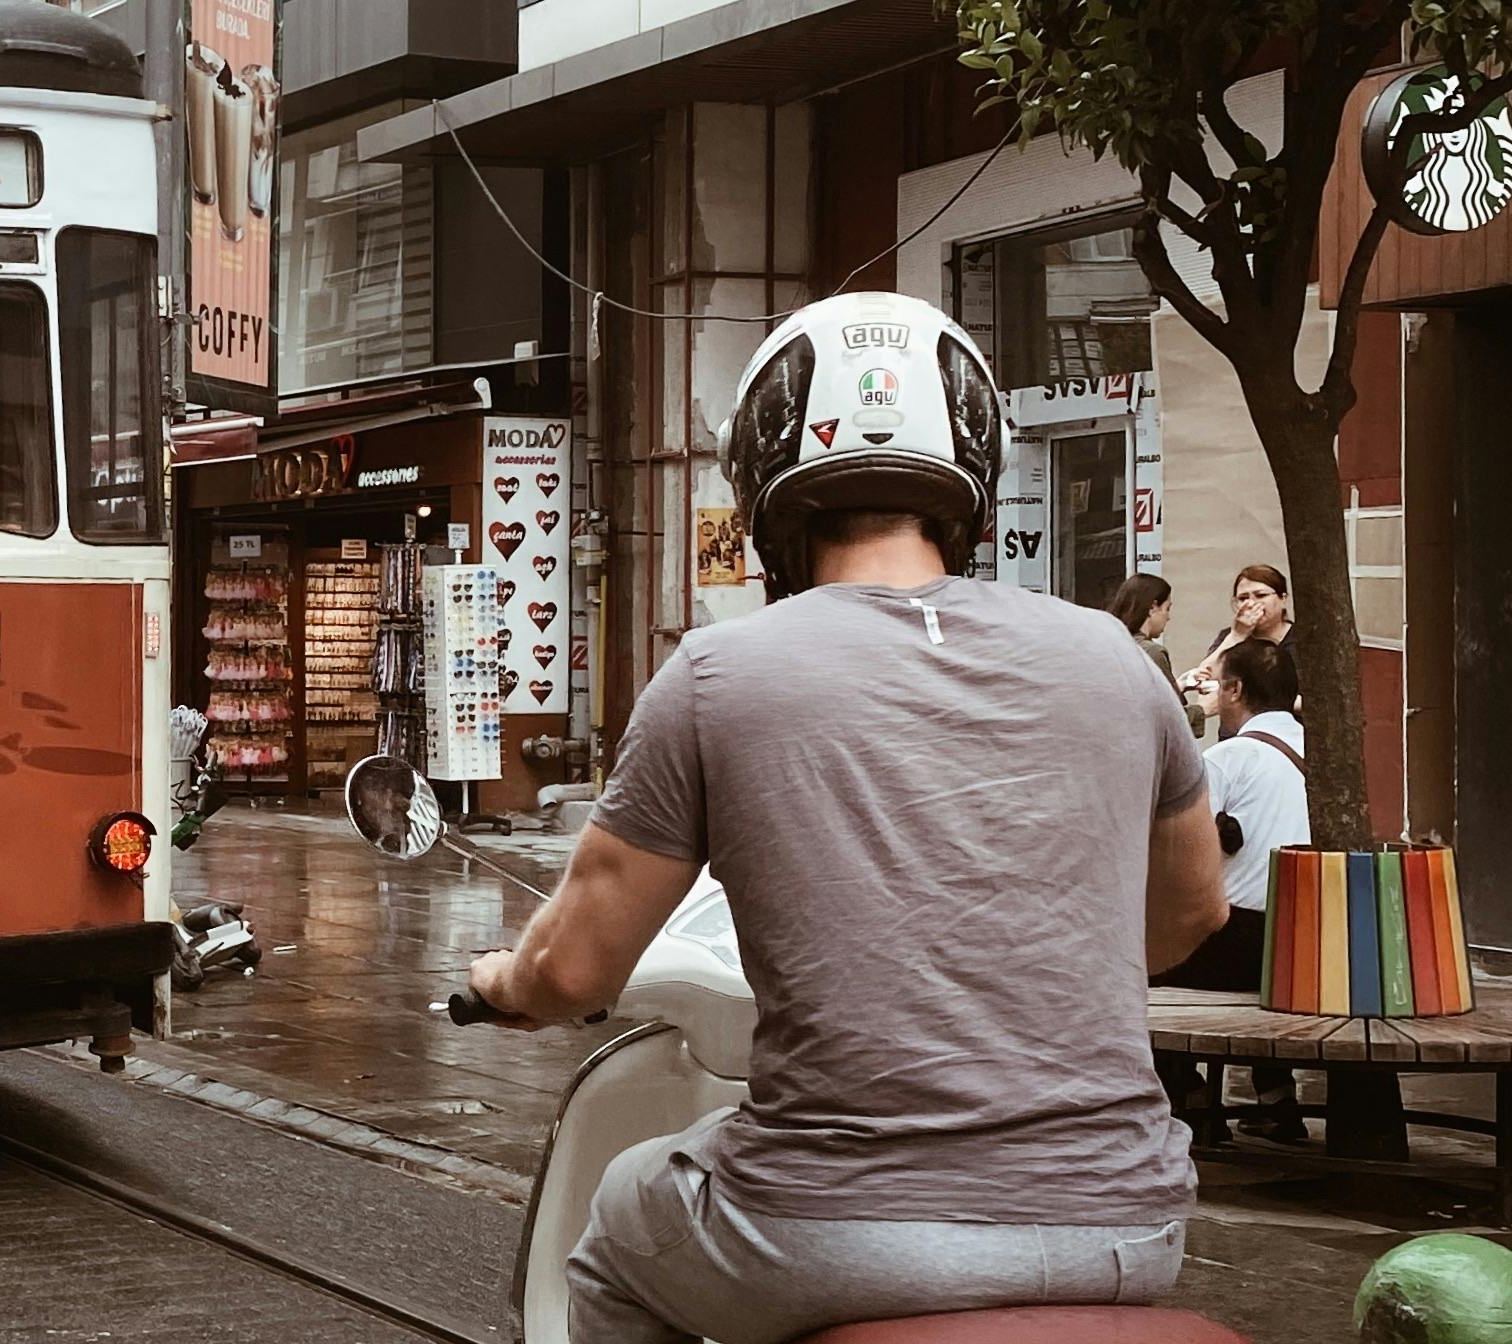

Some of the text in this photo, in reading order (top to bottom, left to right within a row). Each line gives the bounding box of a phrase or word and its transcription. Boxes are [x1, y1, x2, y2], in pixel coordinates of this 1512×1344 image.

[198, 303, 263, 364] COFFY
[488, 428, 555, 449] MODA
[495, 454, 557, 465] accessories
